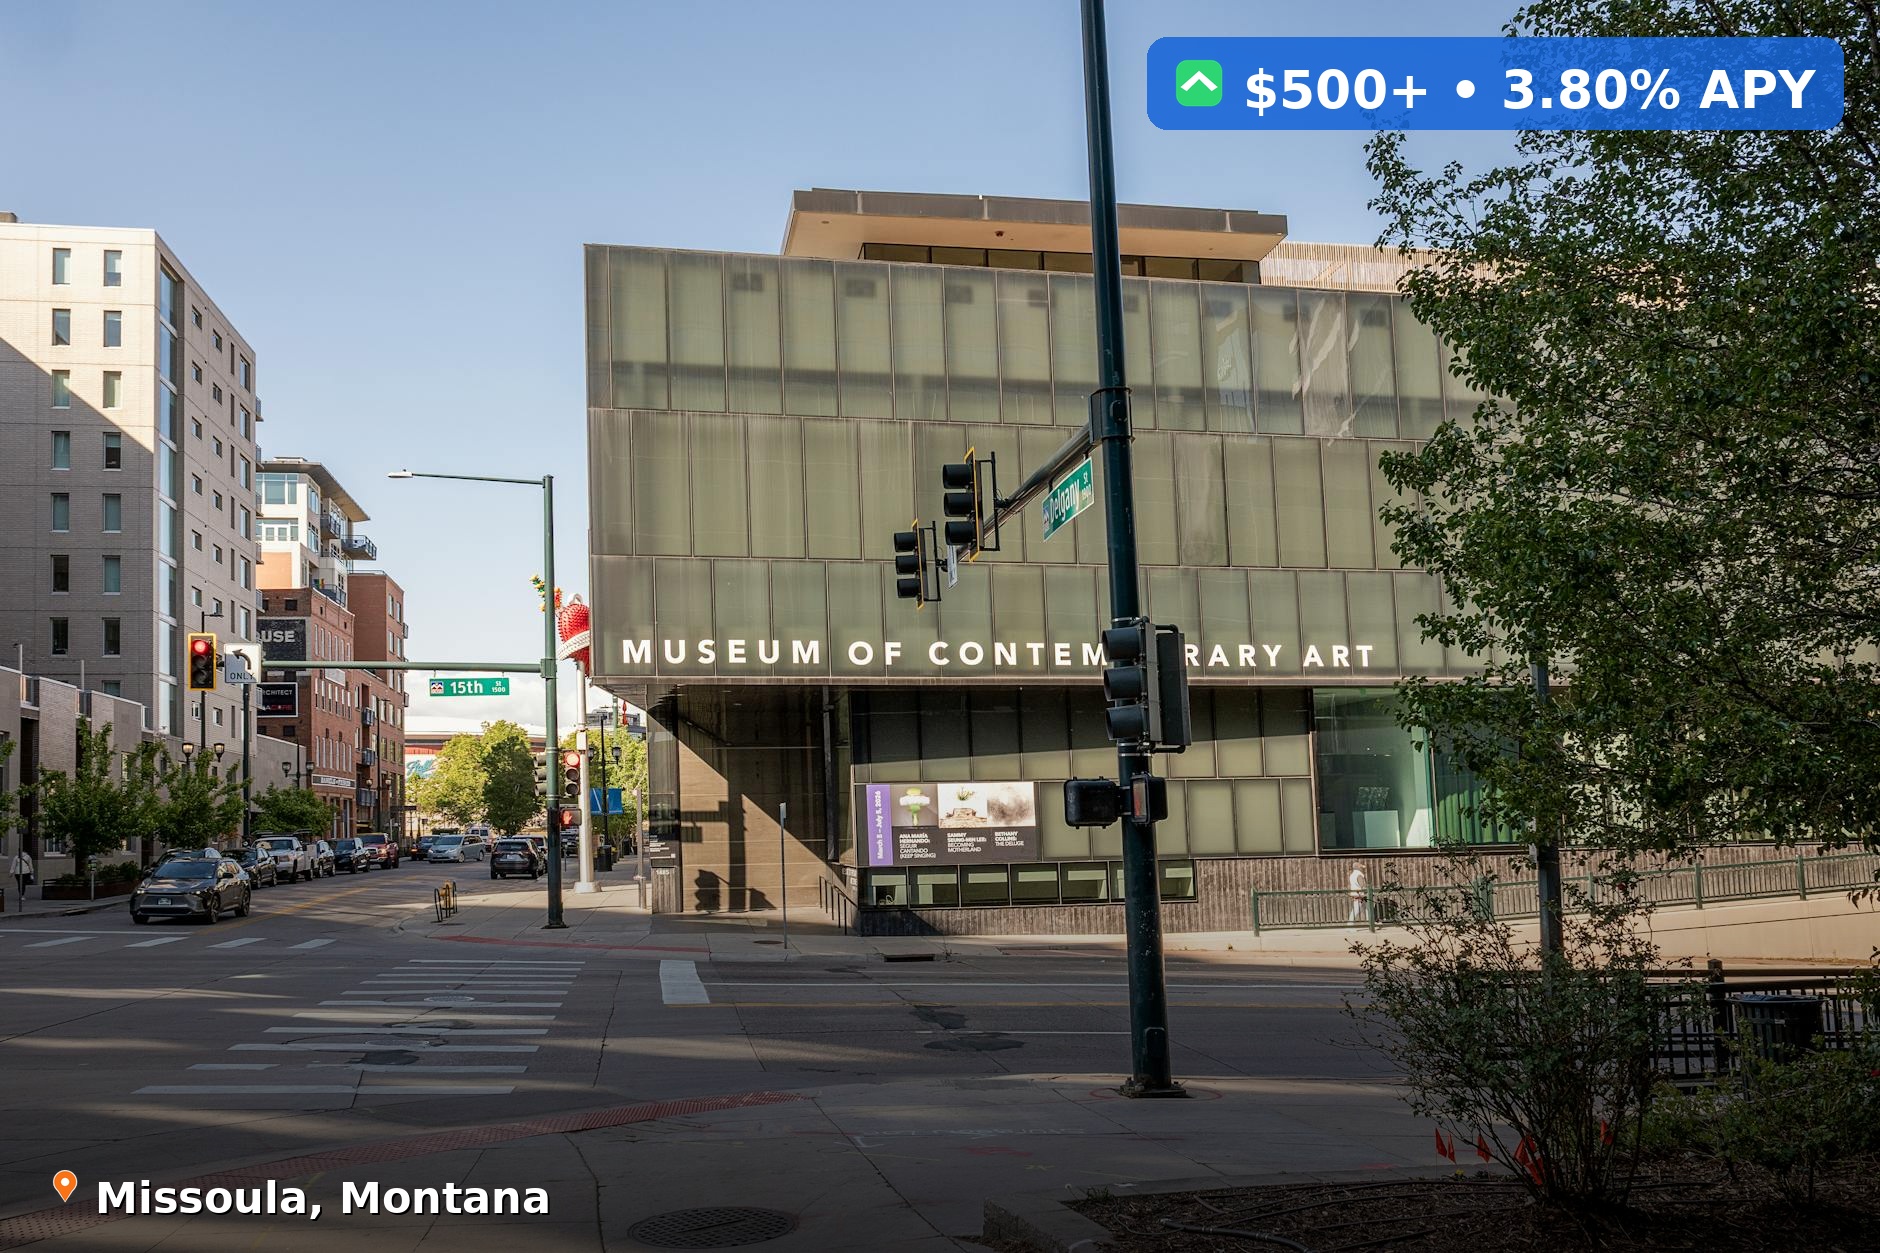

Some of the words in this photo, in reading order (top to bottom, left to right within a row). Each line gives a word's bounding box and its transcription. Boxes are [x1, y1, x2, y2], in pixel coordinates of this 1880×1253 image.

[1050, 479, 1080, 523] Delgany
[258, 630, 295, 643] USE
[622, 639, 820, 665] MUSEUM
[848, 641, 902, 666] OF
[928, 641, 1282, 667] CONTEMRARY
[1303, 644, 1374, 667] ART
[230, 672, 255, 680] ONLY
[450, 681, 483, 694] 15th
[875, 815, 883, 829] July
